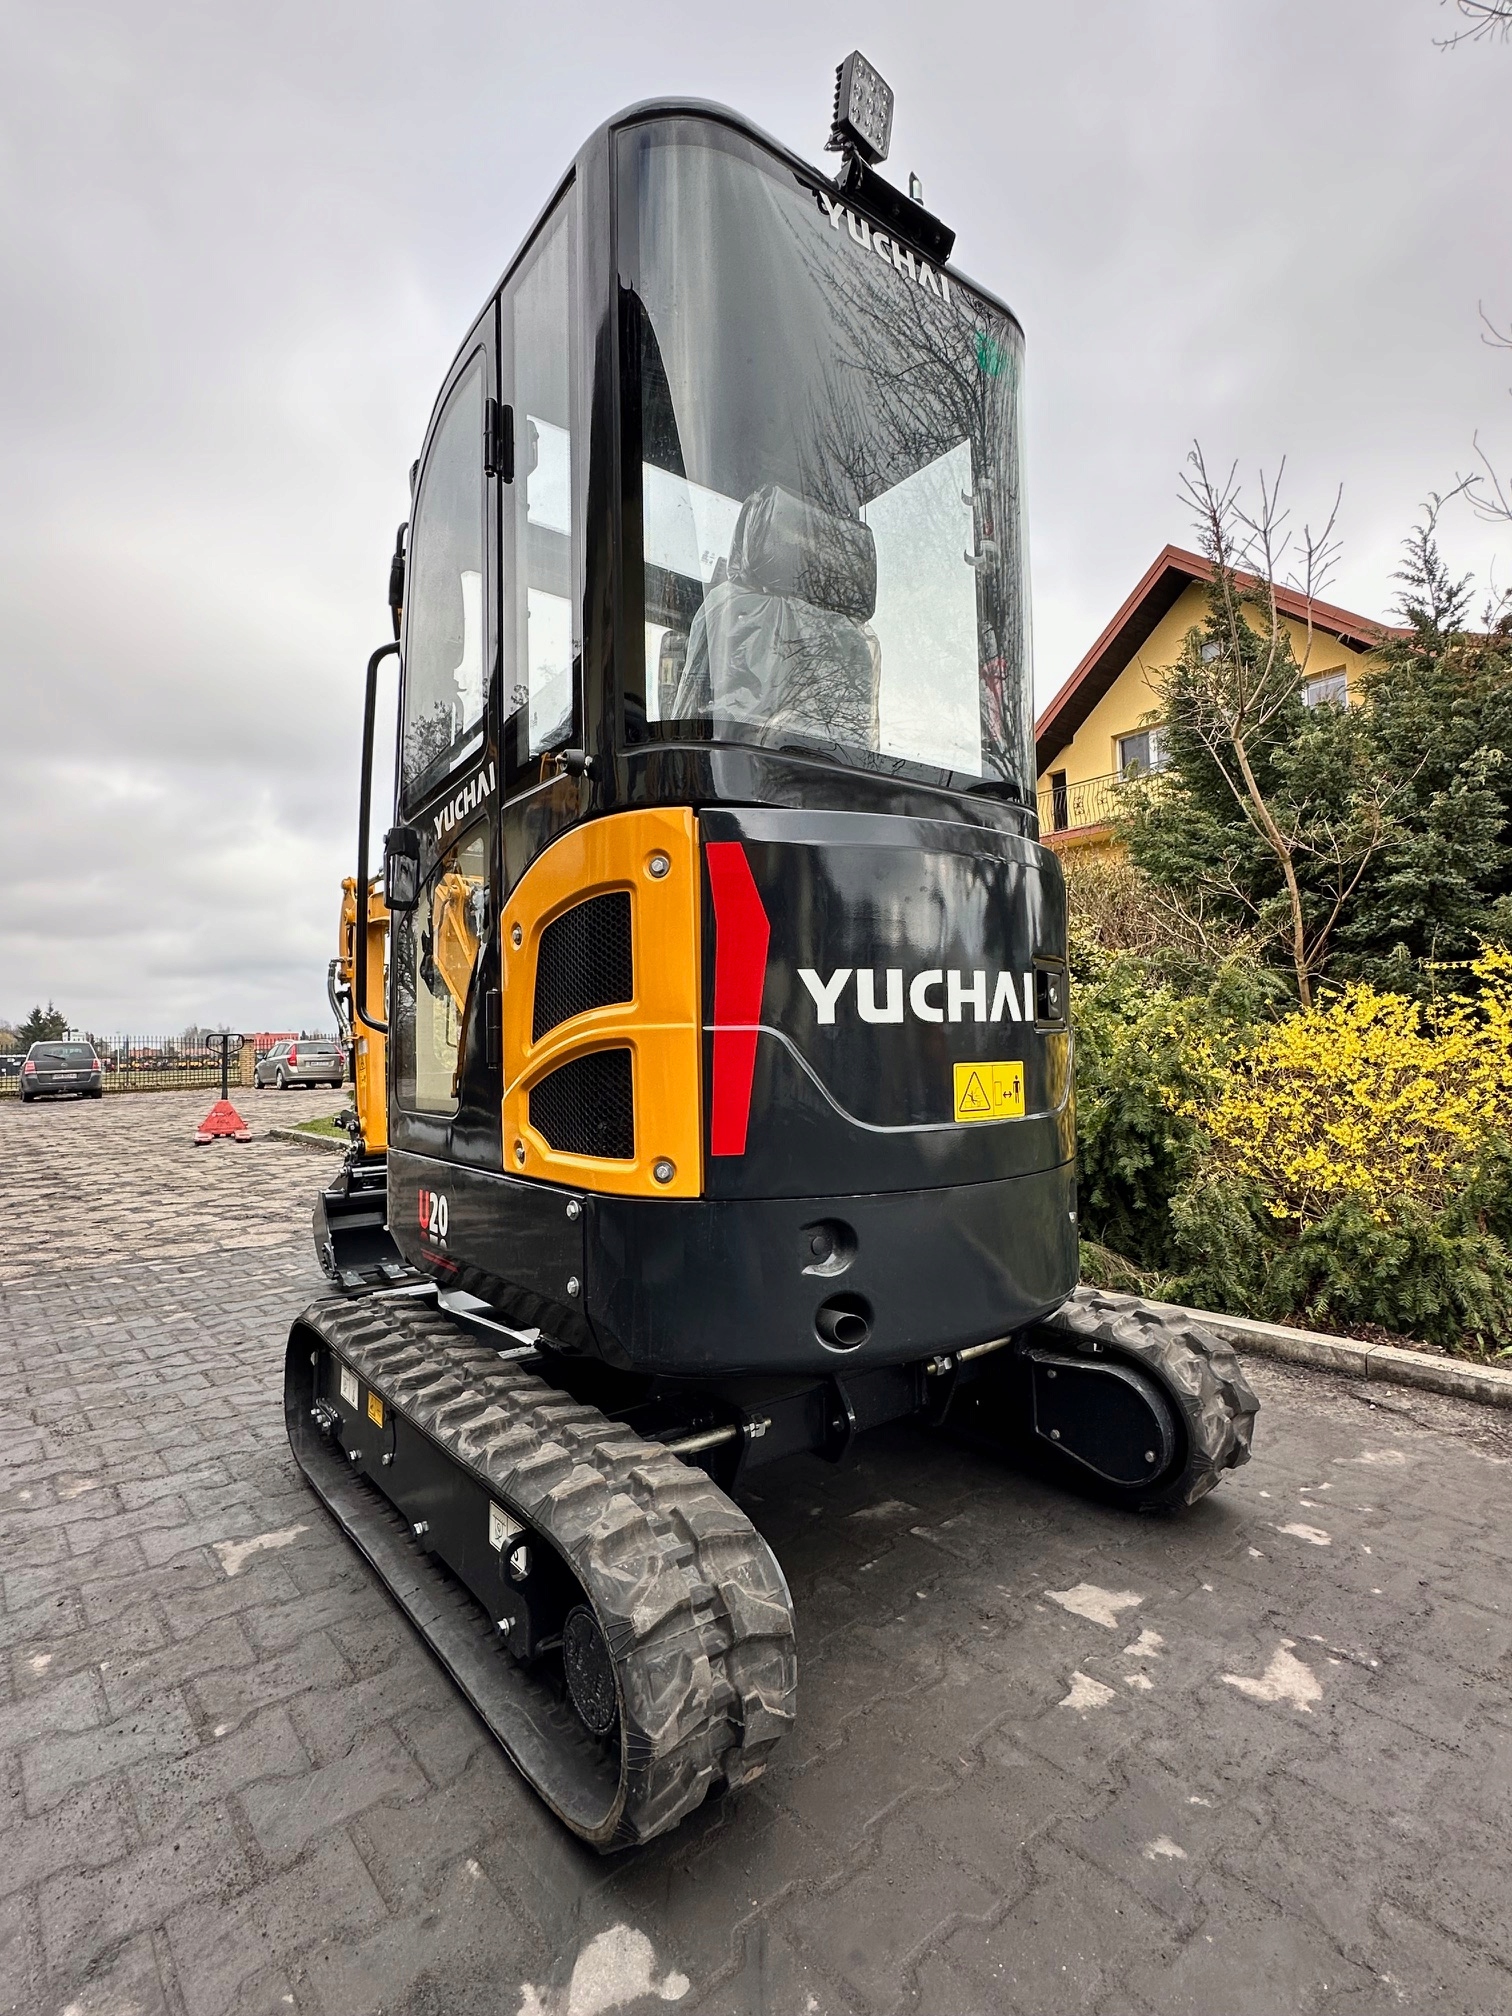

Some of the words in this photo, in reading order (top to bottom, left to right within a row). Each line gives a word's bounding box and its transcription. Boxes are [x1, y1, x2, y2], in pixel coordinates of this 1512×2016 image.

[819, 190, 951, 304] YUCHAI
[433, 761, 497, 840] YUCHAI
[797, 968, 1035, 1024] YUCHAI
[418, 1189, 449, 1236] U20
